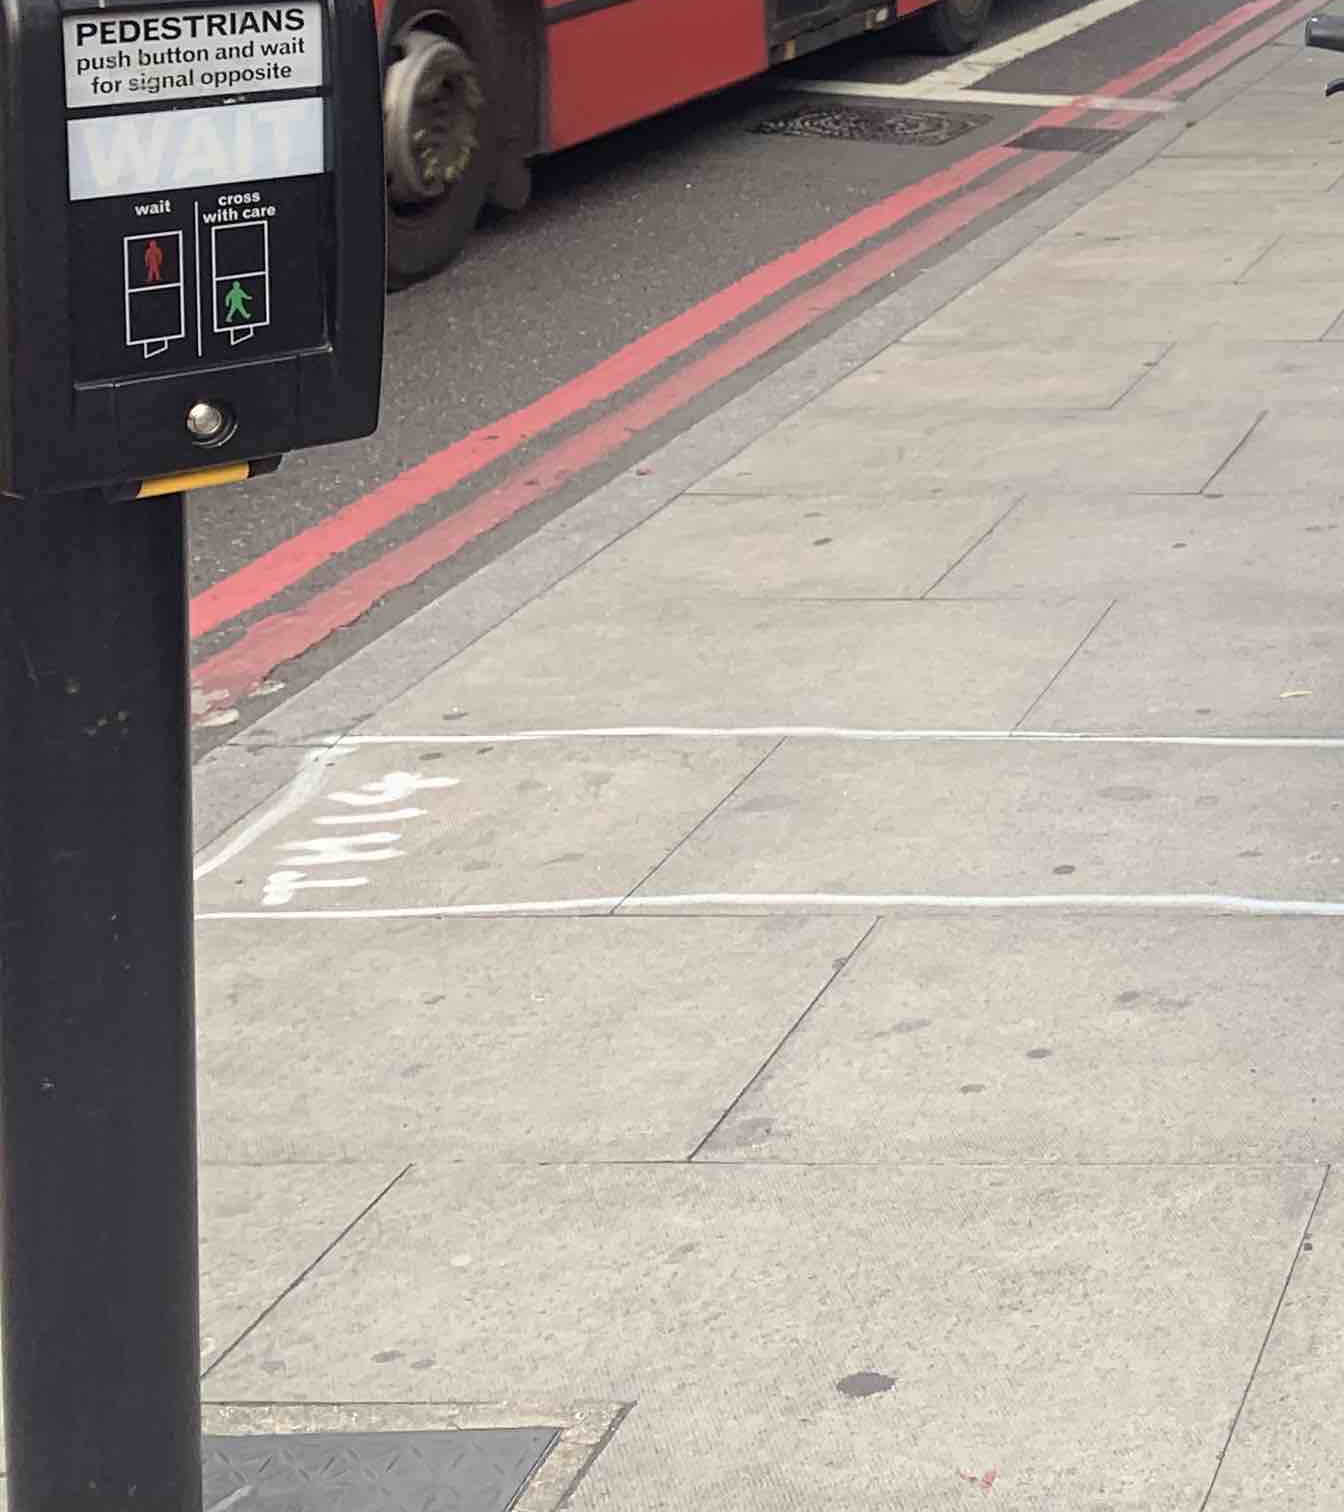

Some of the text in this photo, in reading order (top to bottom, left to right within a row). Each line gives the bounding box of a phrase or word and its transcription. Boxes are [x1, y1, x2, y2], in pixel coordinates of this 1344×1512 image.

[76, 7, 306, 48] PEDESTRIANS
[76, 37, 305, 76] push button and wait
[90, 63, 293, 95] for signal opposite
[85, 104, 306, 190] WAIT
[134, 199, 172, 216] wait
[202, 205, 277, 224] with care
[217, 190, 261, 207] cross
